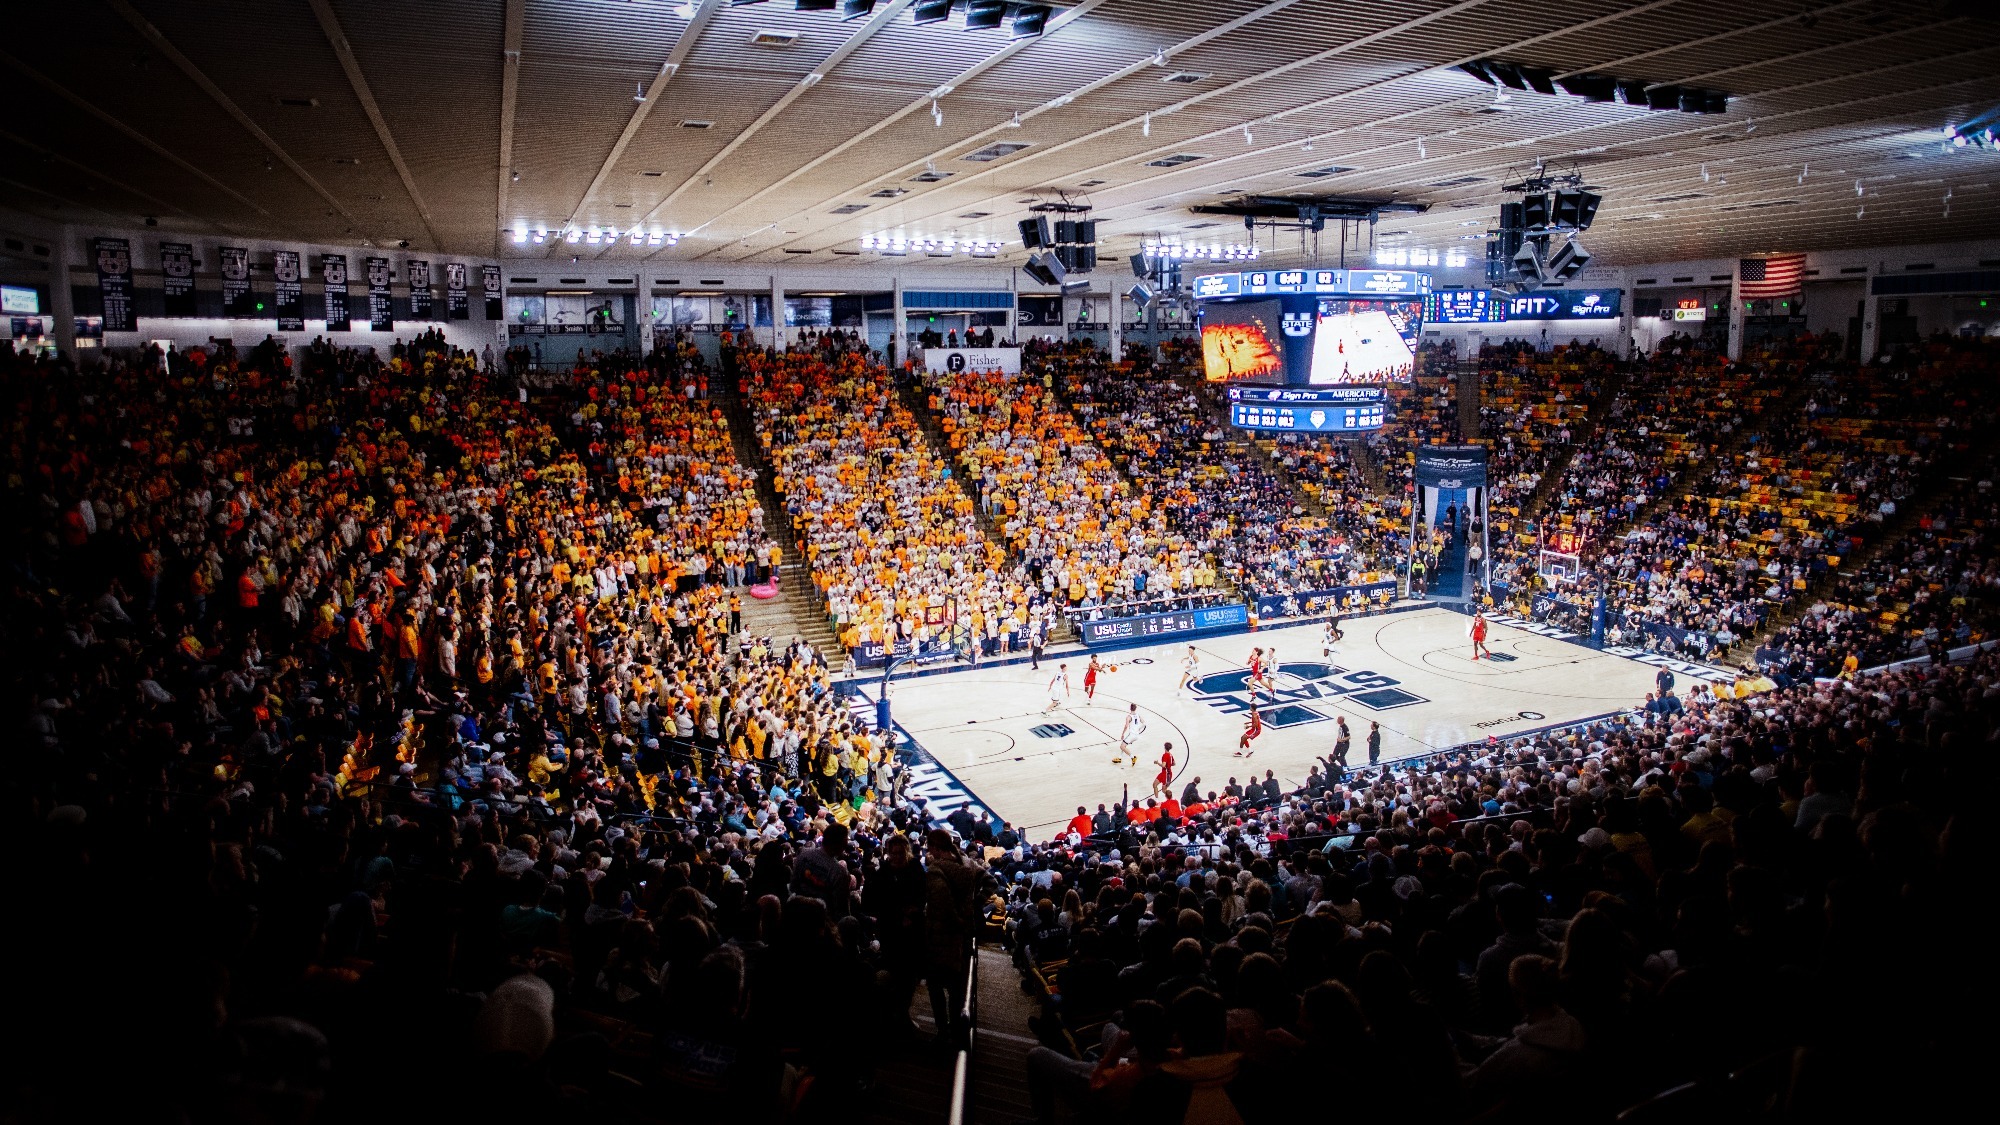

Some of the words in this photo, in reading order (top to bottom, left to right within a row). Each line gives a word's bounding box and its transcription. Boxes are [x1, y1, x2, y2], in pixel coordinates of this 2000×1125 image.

[1571, 305, 1592, 315] Sign
[1593, 306, 1610, 314] Pro
[1282, 319, 1313, 329] STATE
[968, 354, 1001, 365] Fisher
[1282, 391, 1302, 400] Sign
[1302, 392, 1318, 400] Pro
[1332, 389, 1365, 398] AMERICA
[1420, 459, 1457, 468] AMERICA
[1203, 610, 1224, 622] USU
[1094, 623, 1117, 636] USU
